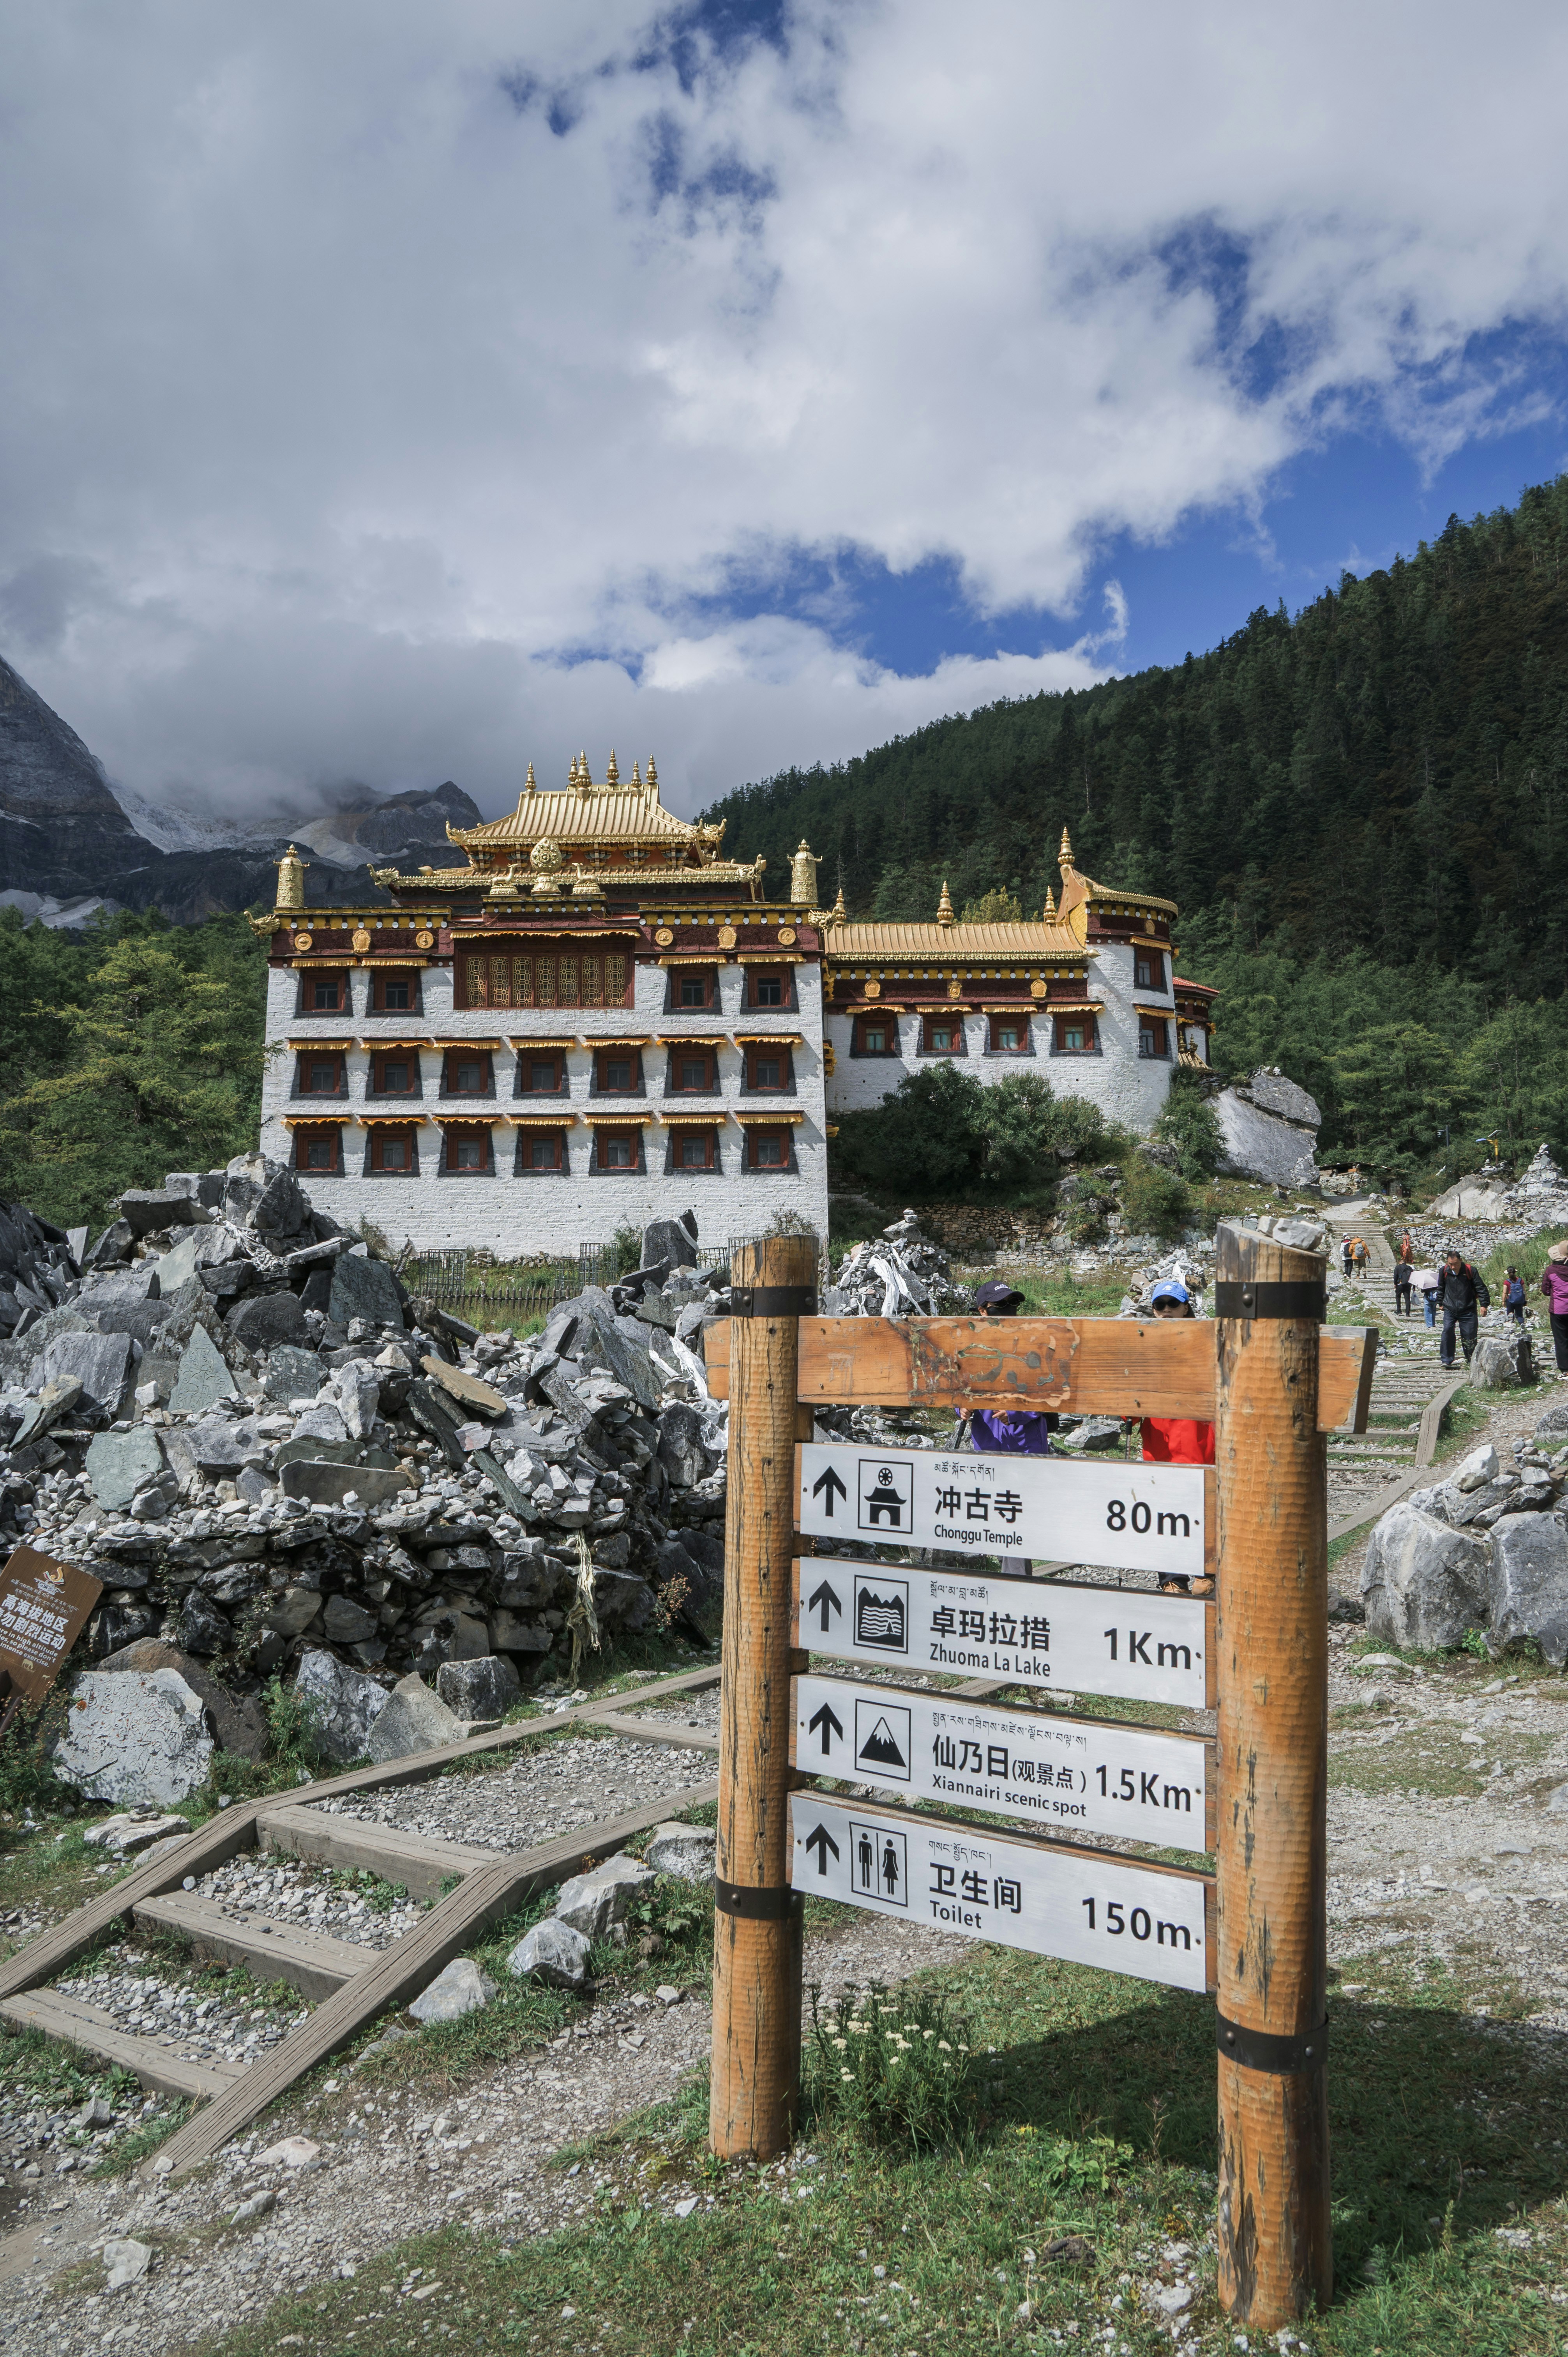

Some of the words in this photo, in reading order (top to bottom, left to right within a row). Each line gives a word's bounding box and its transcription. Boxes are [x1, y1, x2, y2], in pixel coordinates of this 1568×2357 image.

[935, 1486, 1022, 1523] 冲古寺
[1107, 1500, 1190, 1537] 80m
[934, 1524, 982, 1544] Chonggu
[983, 1529, 1022, 1548] Temple
[2, 1594, 69, 1633] 高海拔地区
[930, 1605, 1050, 1652] 卓玛拉措
[1, 1641, 23, 1655] intense
[23, 1652, 49, 1667] exercise.
[16, 1634, 31, 1645] high
[32, 1643, 58, 1657] altitude
[17, 1643, 38, 1655] please
[39, 1652, 56, 1663] don't
[930, 1643, 989, 1668] Zhuoma
[994, 1652, 1010, 1671] La
[1015, 1655, 1050, 1677] Lake
[1104, 1628, 1191, 1670] 1Km
[932, 1774, 1000, 1800] Xiannairi
[1005, 1792, 1049, 1810] scenic
[1053, 1801, 1086, 1817] spot
[1096, 1765, 1190, 1812] 1.5Km
[929, 1862, 1021, 1914] 卫生间
[930, 1900, 982, 1929] Toilet
[1082, 1897, 1190, 1951] 150m
